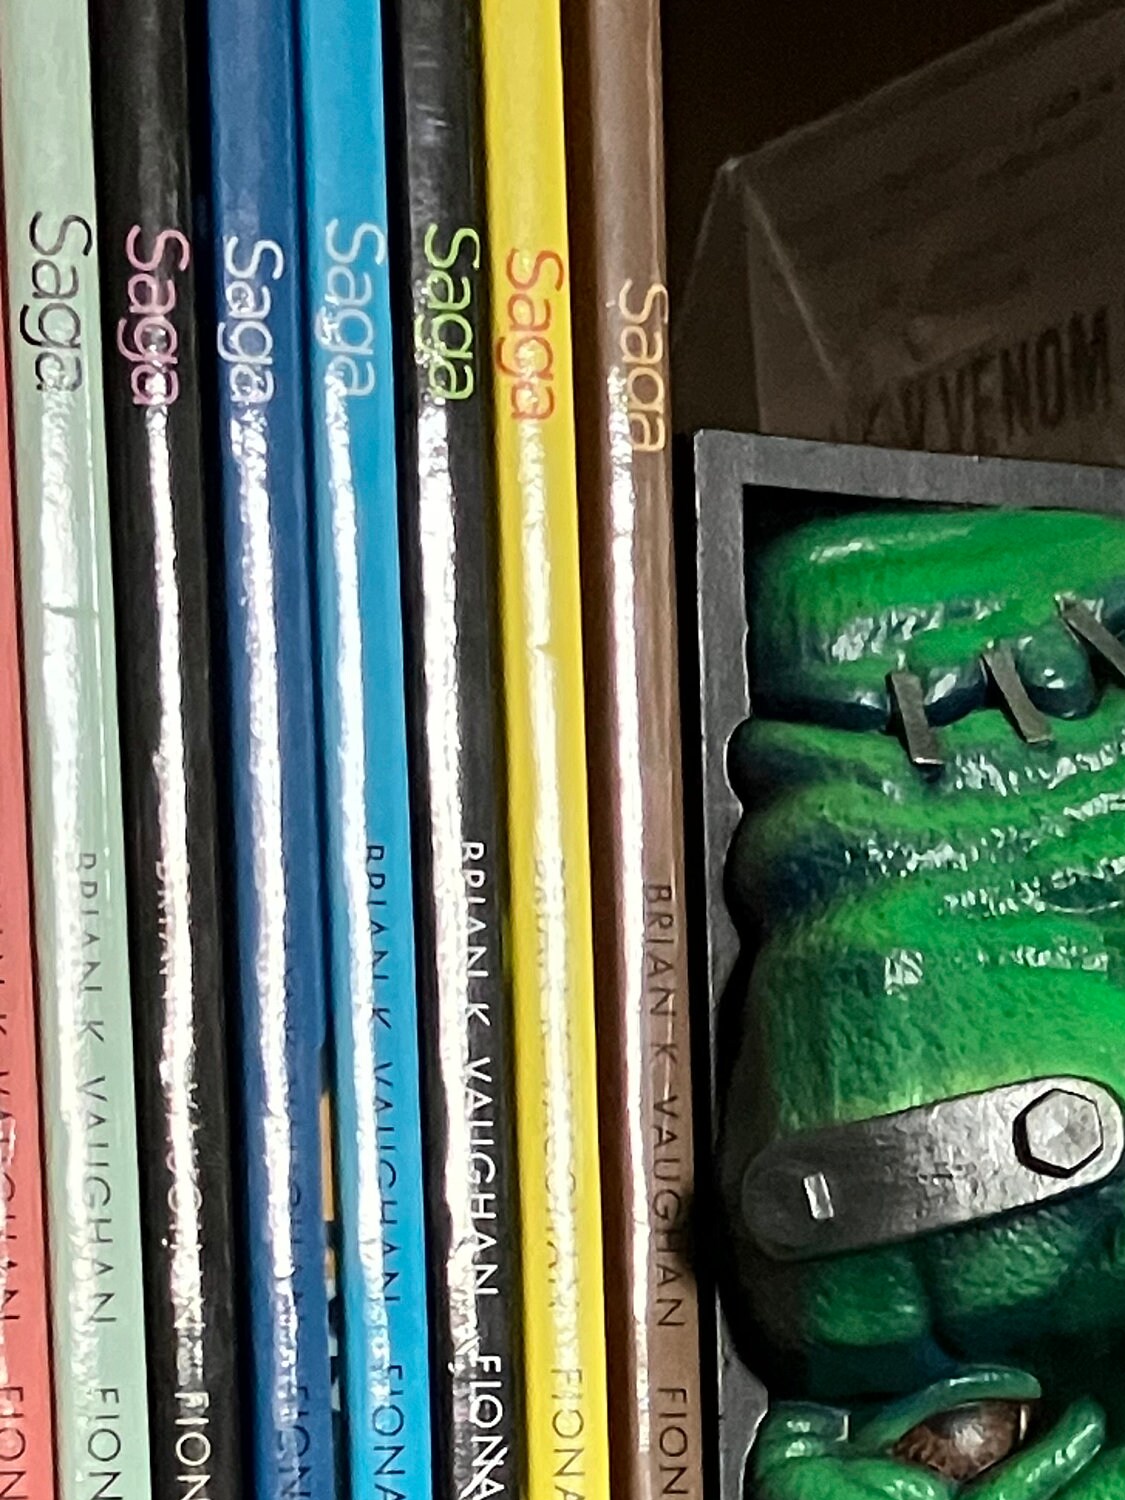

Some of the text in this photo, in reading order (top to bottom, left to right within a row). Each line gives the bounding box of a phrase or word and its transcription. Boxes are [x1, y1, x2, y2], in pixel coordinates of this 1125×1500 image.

[20, 210, 93, 392] Saga
[116, 223, 191, 406] Saga
[216, 235, 284, 404] Saga
[314, 217, 386, 397] Saga
[414, 222, 480, 400] Saga
[495, 247, 565, 421] Saga
[645, 882, 679, 1020] BRIAN
[651, 1094, 687, 1327] VAUGHAN
